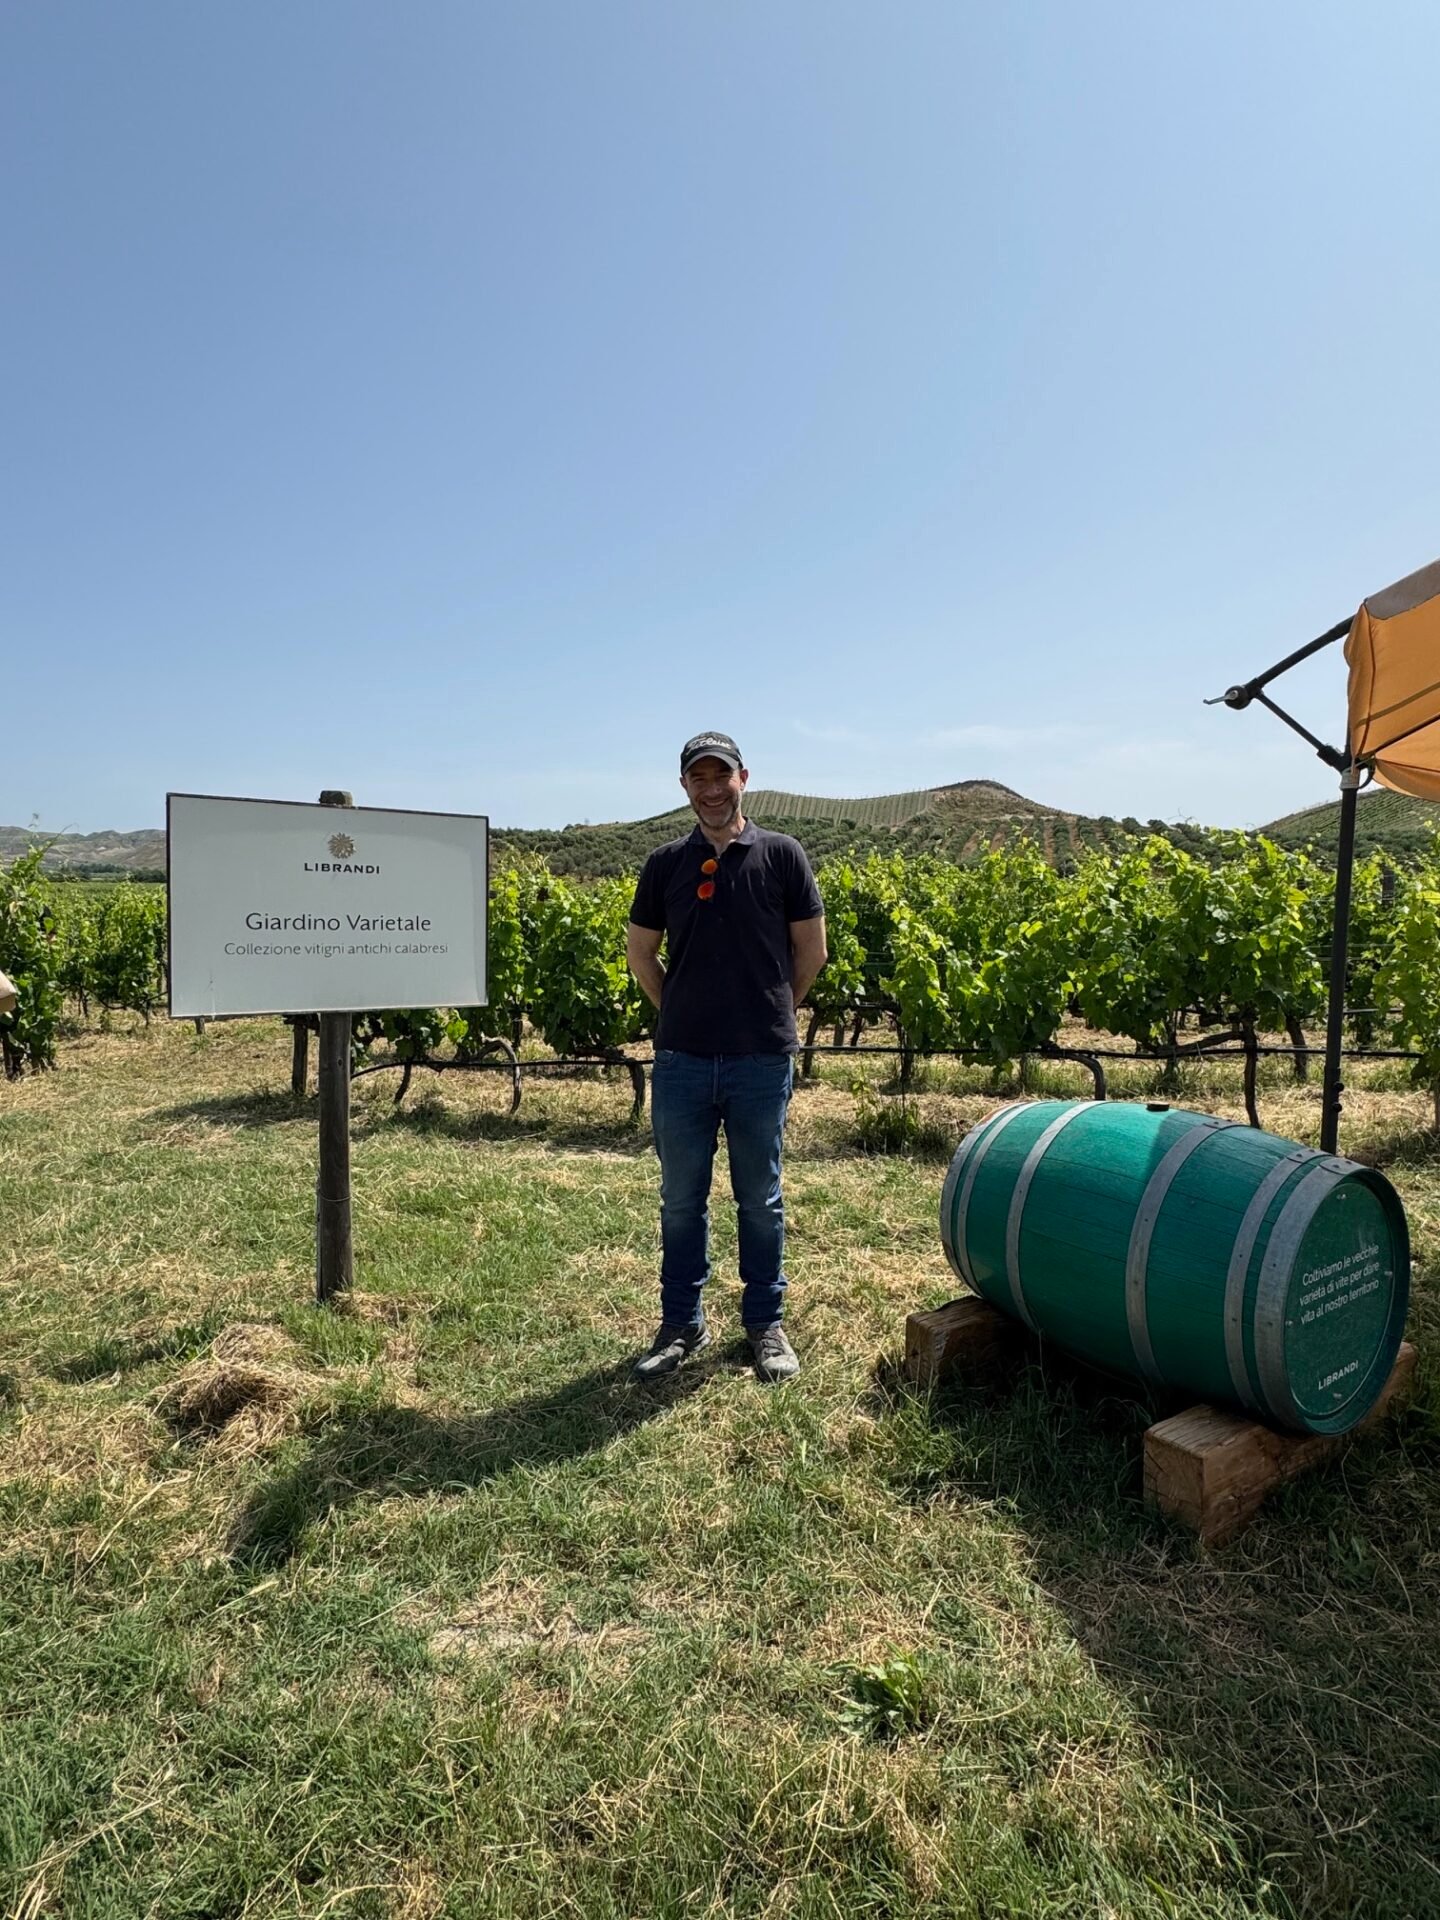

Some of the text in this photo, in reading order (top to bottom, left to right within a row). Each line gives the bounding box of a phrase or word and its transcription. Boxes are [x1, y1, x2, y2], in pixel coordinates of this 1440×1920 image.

[304, 862, 380, 875] LIBRANDI
[246, 912, 431, 931] Giardino Varietale
[224, 942, 448, 958] Collezione vitigni antichi calabresi
[1303, 1243, 1379, 1286] Coltiviamo le vecchie
[1327, 1280, 1335, 1294] di
[1335, 1276, 1349, 1289] vite
[1350, 1270, 1362, 1285] per
[1363, 1262, 1379, 1277] dare
[1301, 1279, 1379, 1325] vita al nostro territorio
[1318, 1360, 1359, 1390] LIBRANDI
